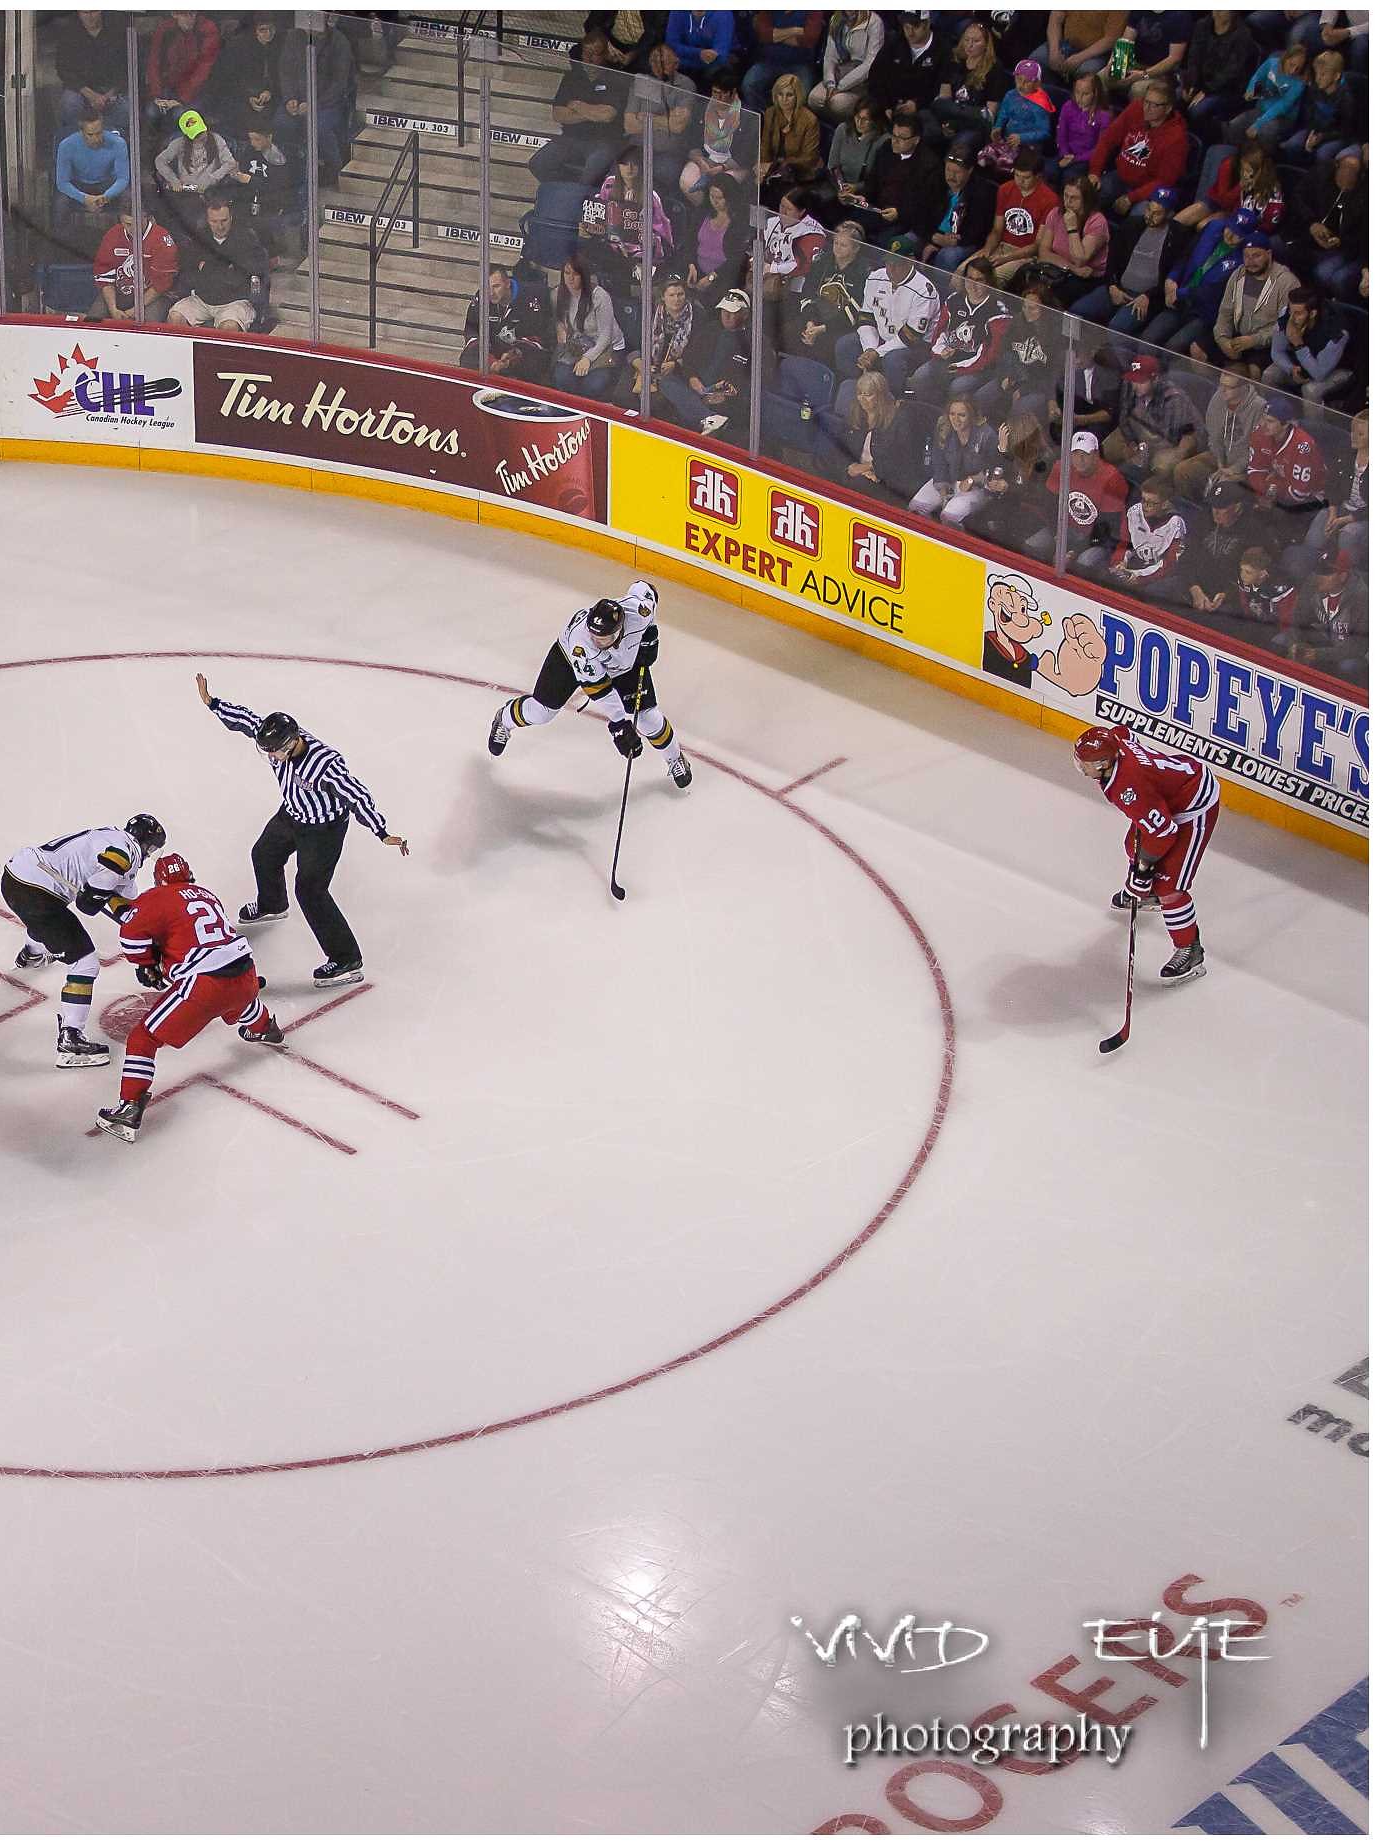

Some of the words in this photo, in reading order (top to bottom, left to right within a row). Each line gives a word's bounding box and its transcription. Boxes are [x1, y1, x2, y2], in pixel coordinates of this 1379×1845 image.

[373, 114, 409, 129] IBEW
[431, 123, 449, 134] 303
[332, 210, 366, 224] IBEW
[445, 226, 480, 241] IBEW
[504, 236, 522, 247] 303
[75, 369, 155, 416] CHL
[216, 372, 293, 426] Tim
[85, 413, 119, 424] Canadian
[120, 416, 148, 428] Hockey
[149, 416, 175, 430] League
[495, 459, 533, 496] Tim
[521, 418, 591, 481] Hortons
[685, 521, 793, 587] EXPERT
[799, 569, 905, 634] ADVICE
[1097, 701, 1230, 766] SUPPLEMENTS
[1231, 751, 1313, 799] LOWEST
